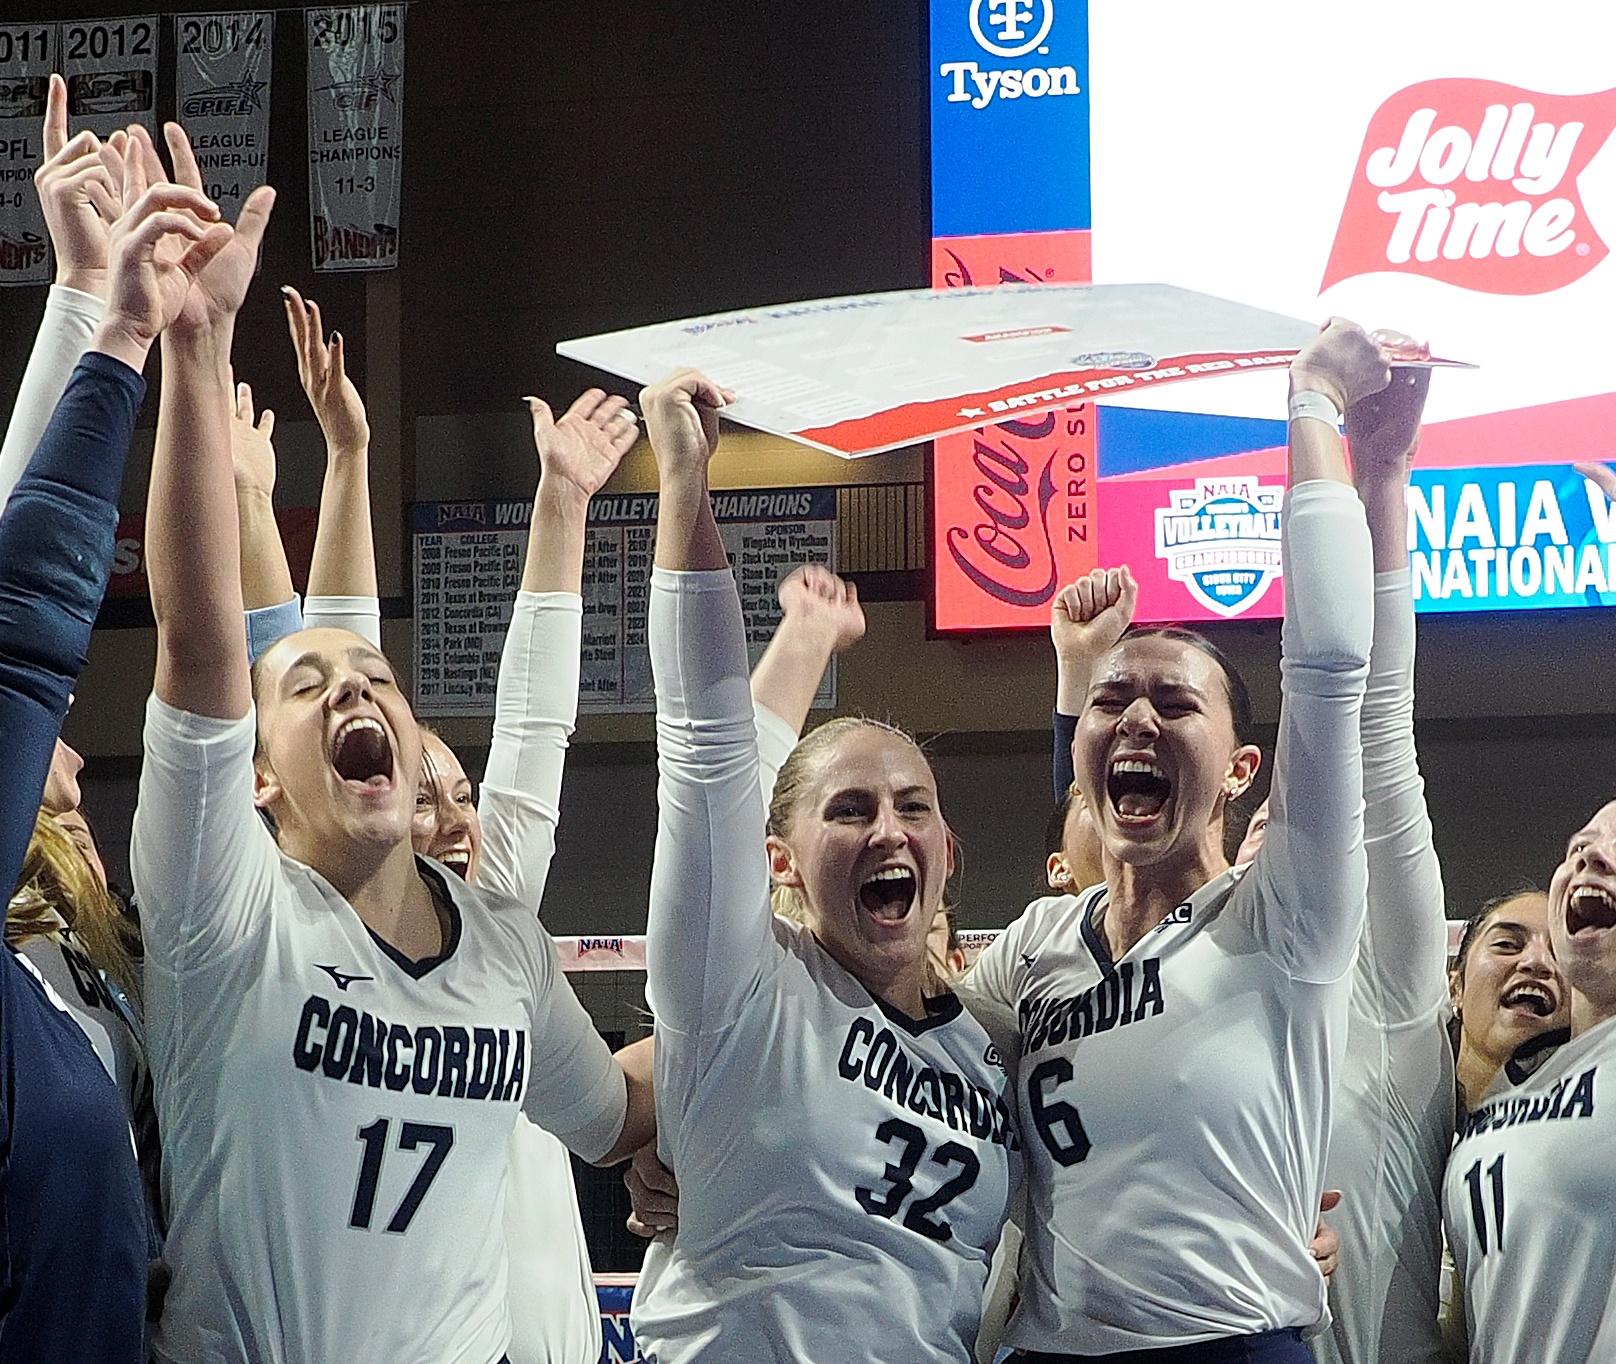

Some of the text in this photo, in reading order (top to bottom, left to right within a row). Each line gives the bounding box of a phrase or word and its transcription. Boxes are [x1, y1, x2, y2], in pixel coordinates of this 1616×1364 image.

[68, 23, 152, 60] 2012
[184, 19, 264, 54] 2014
[940, 61, 1079, 108] Tyson
[193, 134, 255, 148] LEAGUE
[310, 144, 400, 164] CHAMPIONS
[323, 126, 389, 143] LEAGUE
[1366, 102, 1584, 195] Jolly
[198, 152, 266, 169] NNER-UP
[334, 175, 376, 194] 11-3
[1377, 188, 1576, 263] Time
[988, 384, 1084, 414] BATTLE
[1085, 374, 1135, 393] FOR
[1134, 366, 1185, 384] THE
[712, 494, 812, 518] HAMPIONS
[1068, 453, 1087, 542] ZERO
[1204, 484, 1250, 500] NAIA
[1163, 513, 1281, 547] VOLLEYBAL
[1406, 480, 1569, 550] NAIA
[579, 938, 623, 955] NAIA
[293, 995, 531, 1102] CONCORDIA
[1028, 1055, 1093, 1167] 6
[347, 1116, 456, 1236] 17
[854, 1118, 980, 1241] 32
[1463, 1151, 1506, 1257] 11
